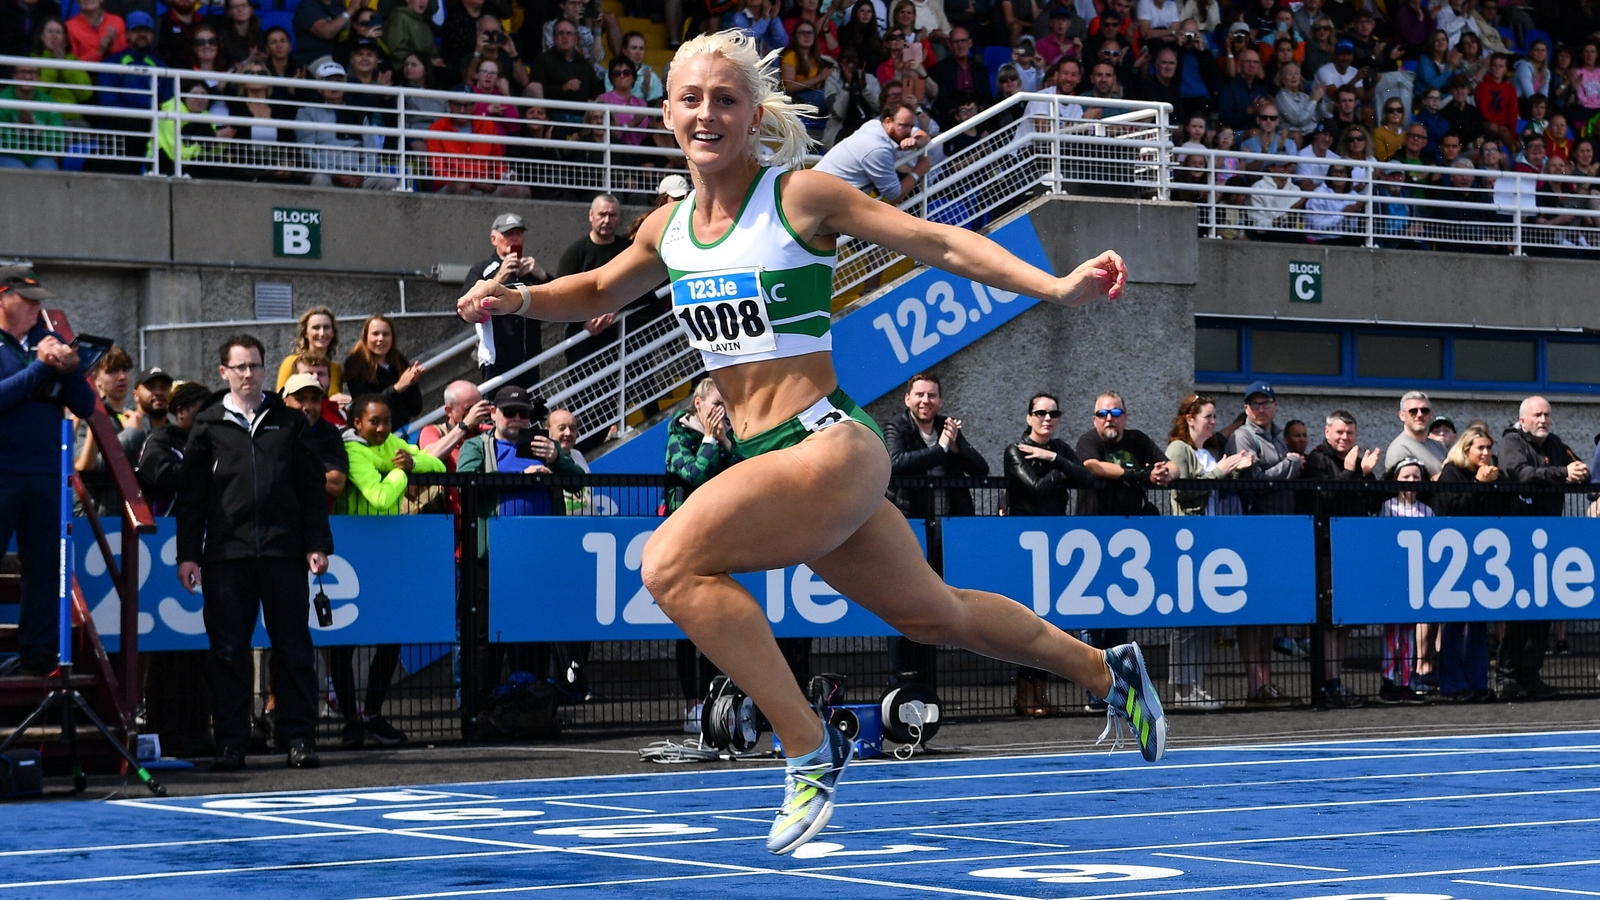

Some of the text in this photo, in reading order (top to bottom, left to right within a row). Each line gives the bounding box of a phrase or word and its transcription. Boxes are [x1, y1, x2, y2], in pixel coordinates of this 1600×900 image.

[274, 210, 320, 224] BLOCK
[283, 223, 311, 255] B
[1289, 263, 1320, 275] BLOCK
[687, 277, 738, 300] 123.ie
[1295, 274, 1315, 300] C
[679, 299, 766, 342] 1008
[710, 341, 741, 353] LAVIN
[582, 531, 849, 625] 12ie
[1019, 529, 1248, 616] 123.ie
[1397, 529, 1595, 609] 123.ie
